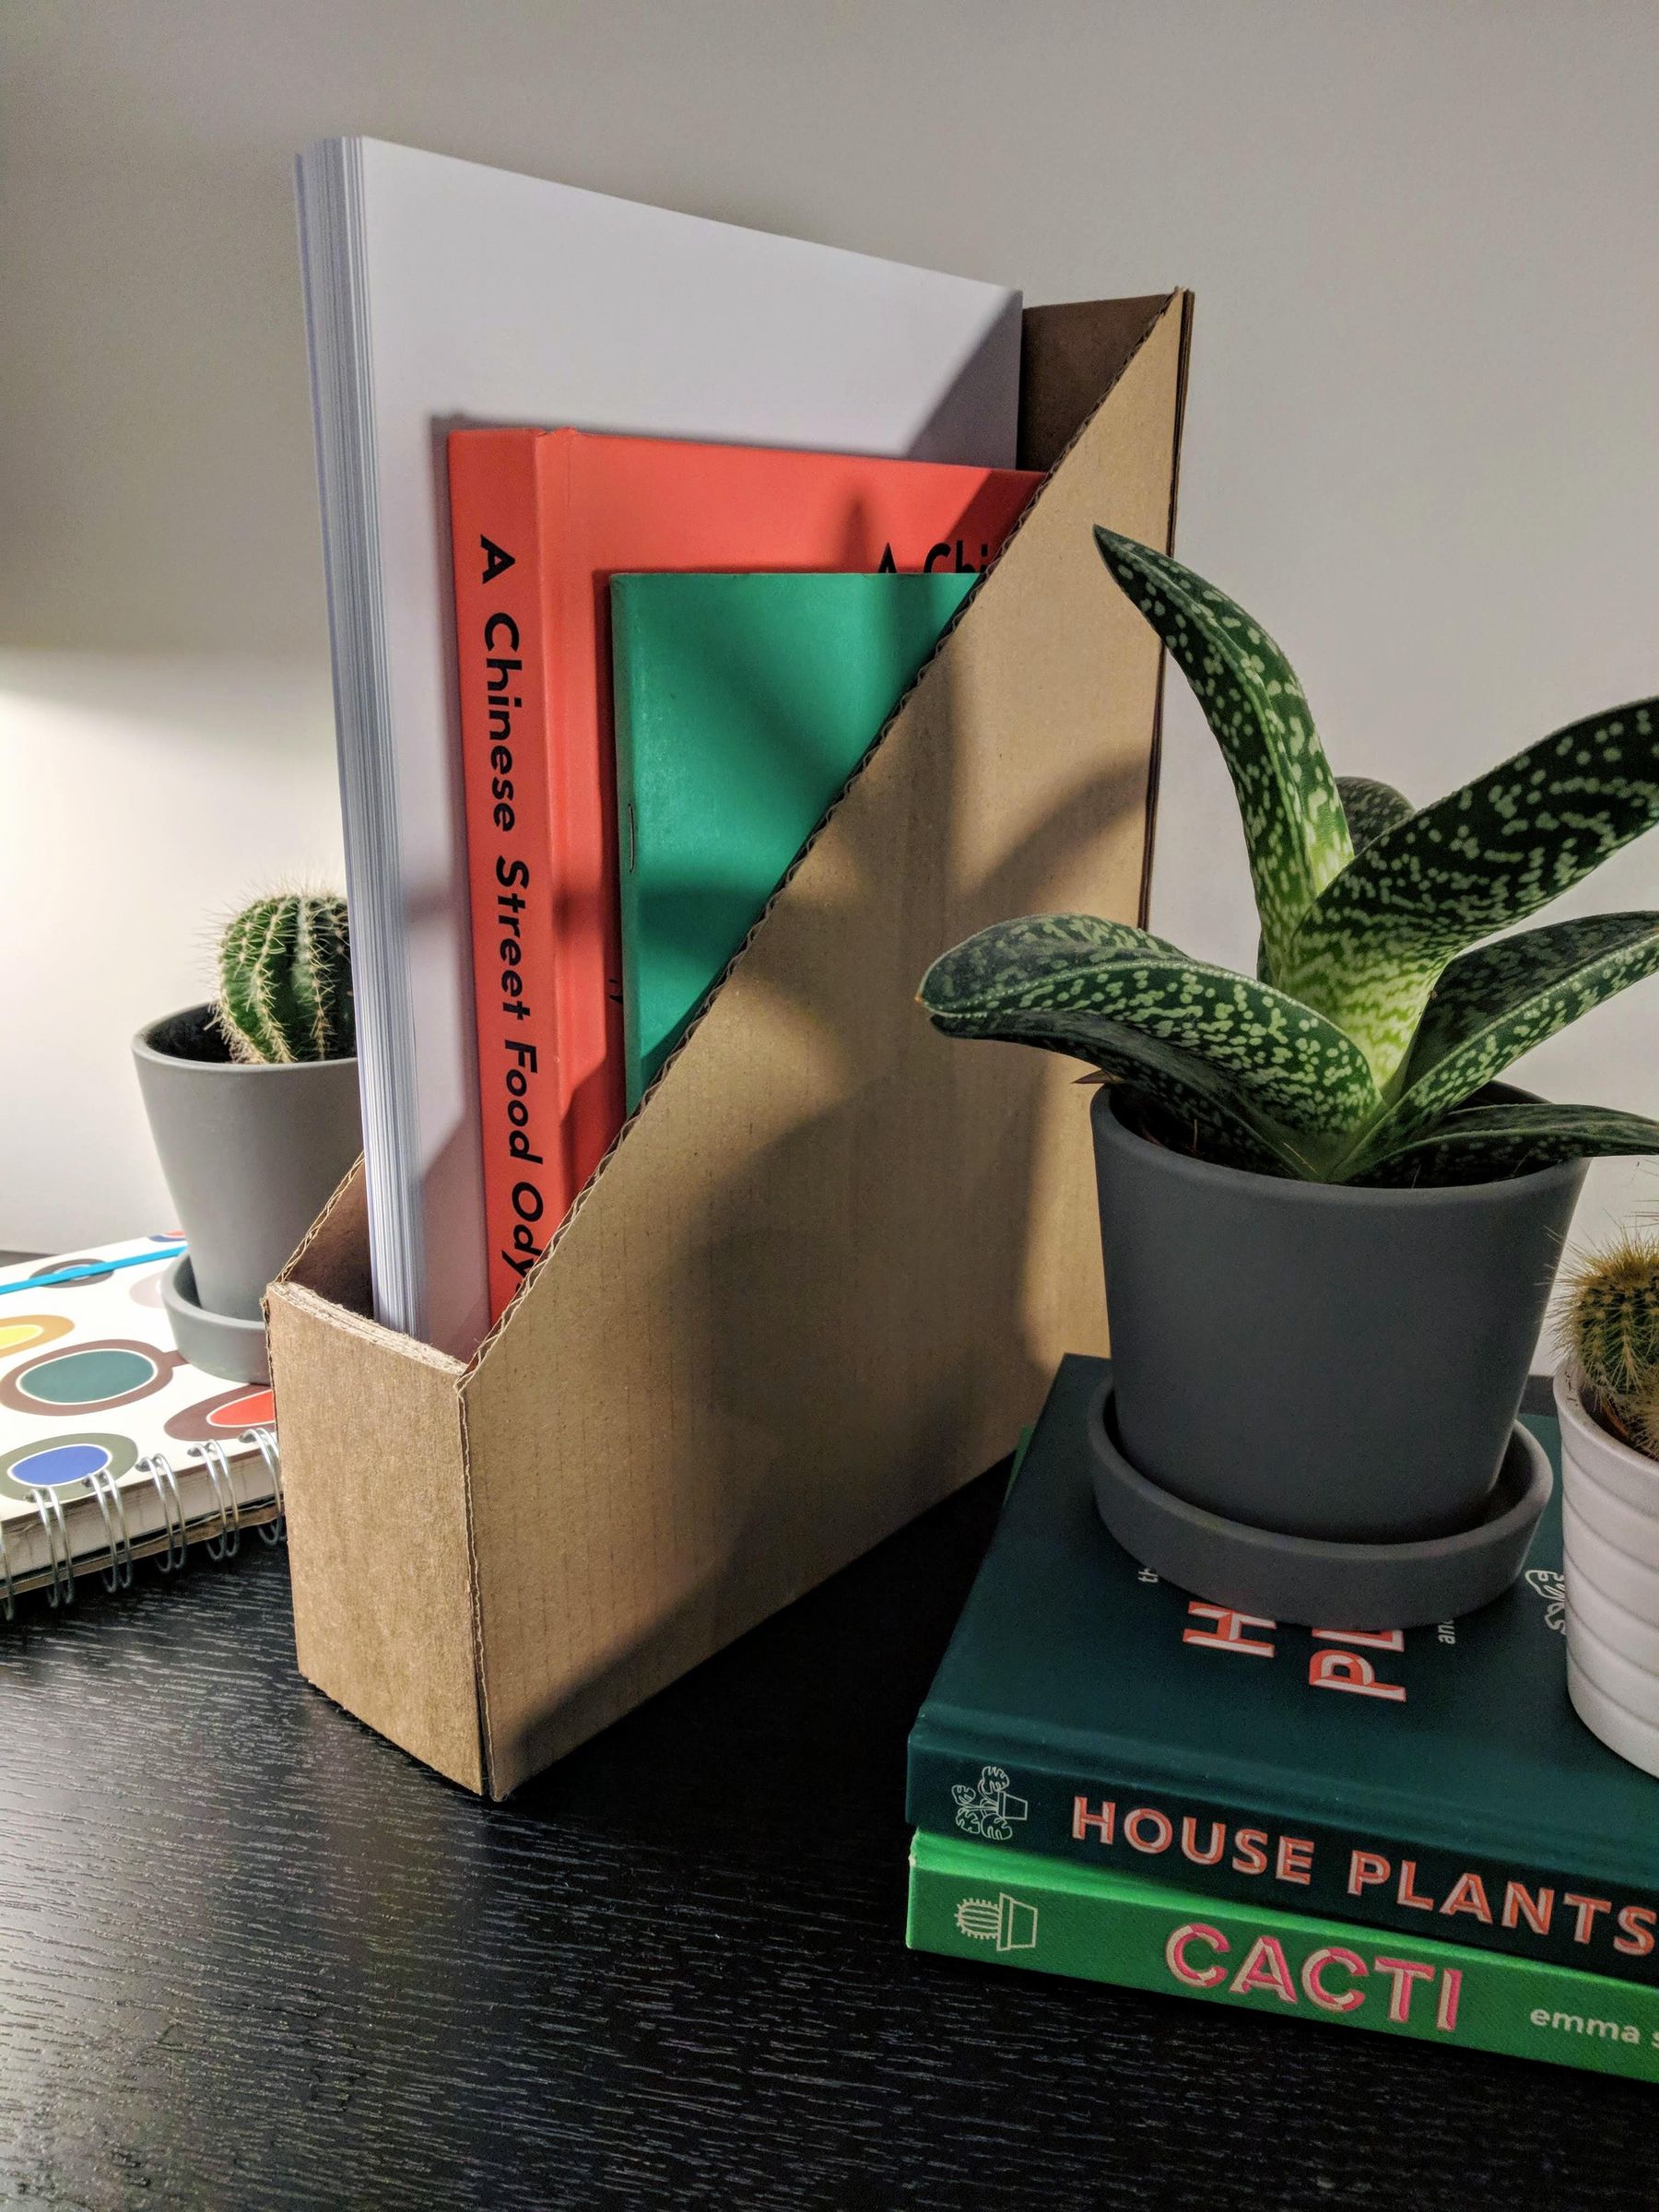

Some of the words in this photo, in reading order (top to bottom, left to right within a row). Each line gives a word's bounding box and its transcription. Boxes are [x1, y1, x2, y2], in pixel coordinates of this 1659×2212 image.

[479, 534, 515, 584] A
[483, 612, 523, 832] Chinese
[495, 855, 531, 1020] Street
[504, 1040, 544, 1165] Food
[501, 1182, 544, 1292] Ody
[1072, 1795, 1314, 1886] HOUSE
[1347, 1849, 1658, 1956] PLANTS
[1165, 1923, 1464, 2032] CACTI
[1530, 2008, 1641, 2045] emma
